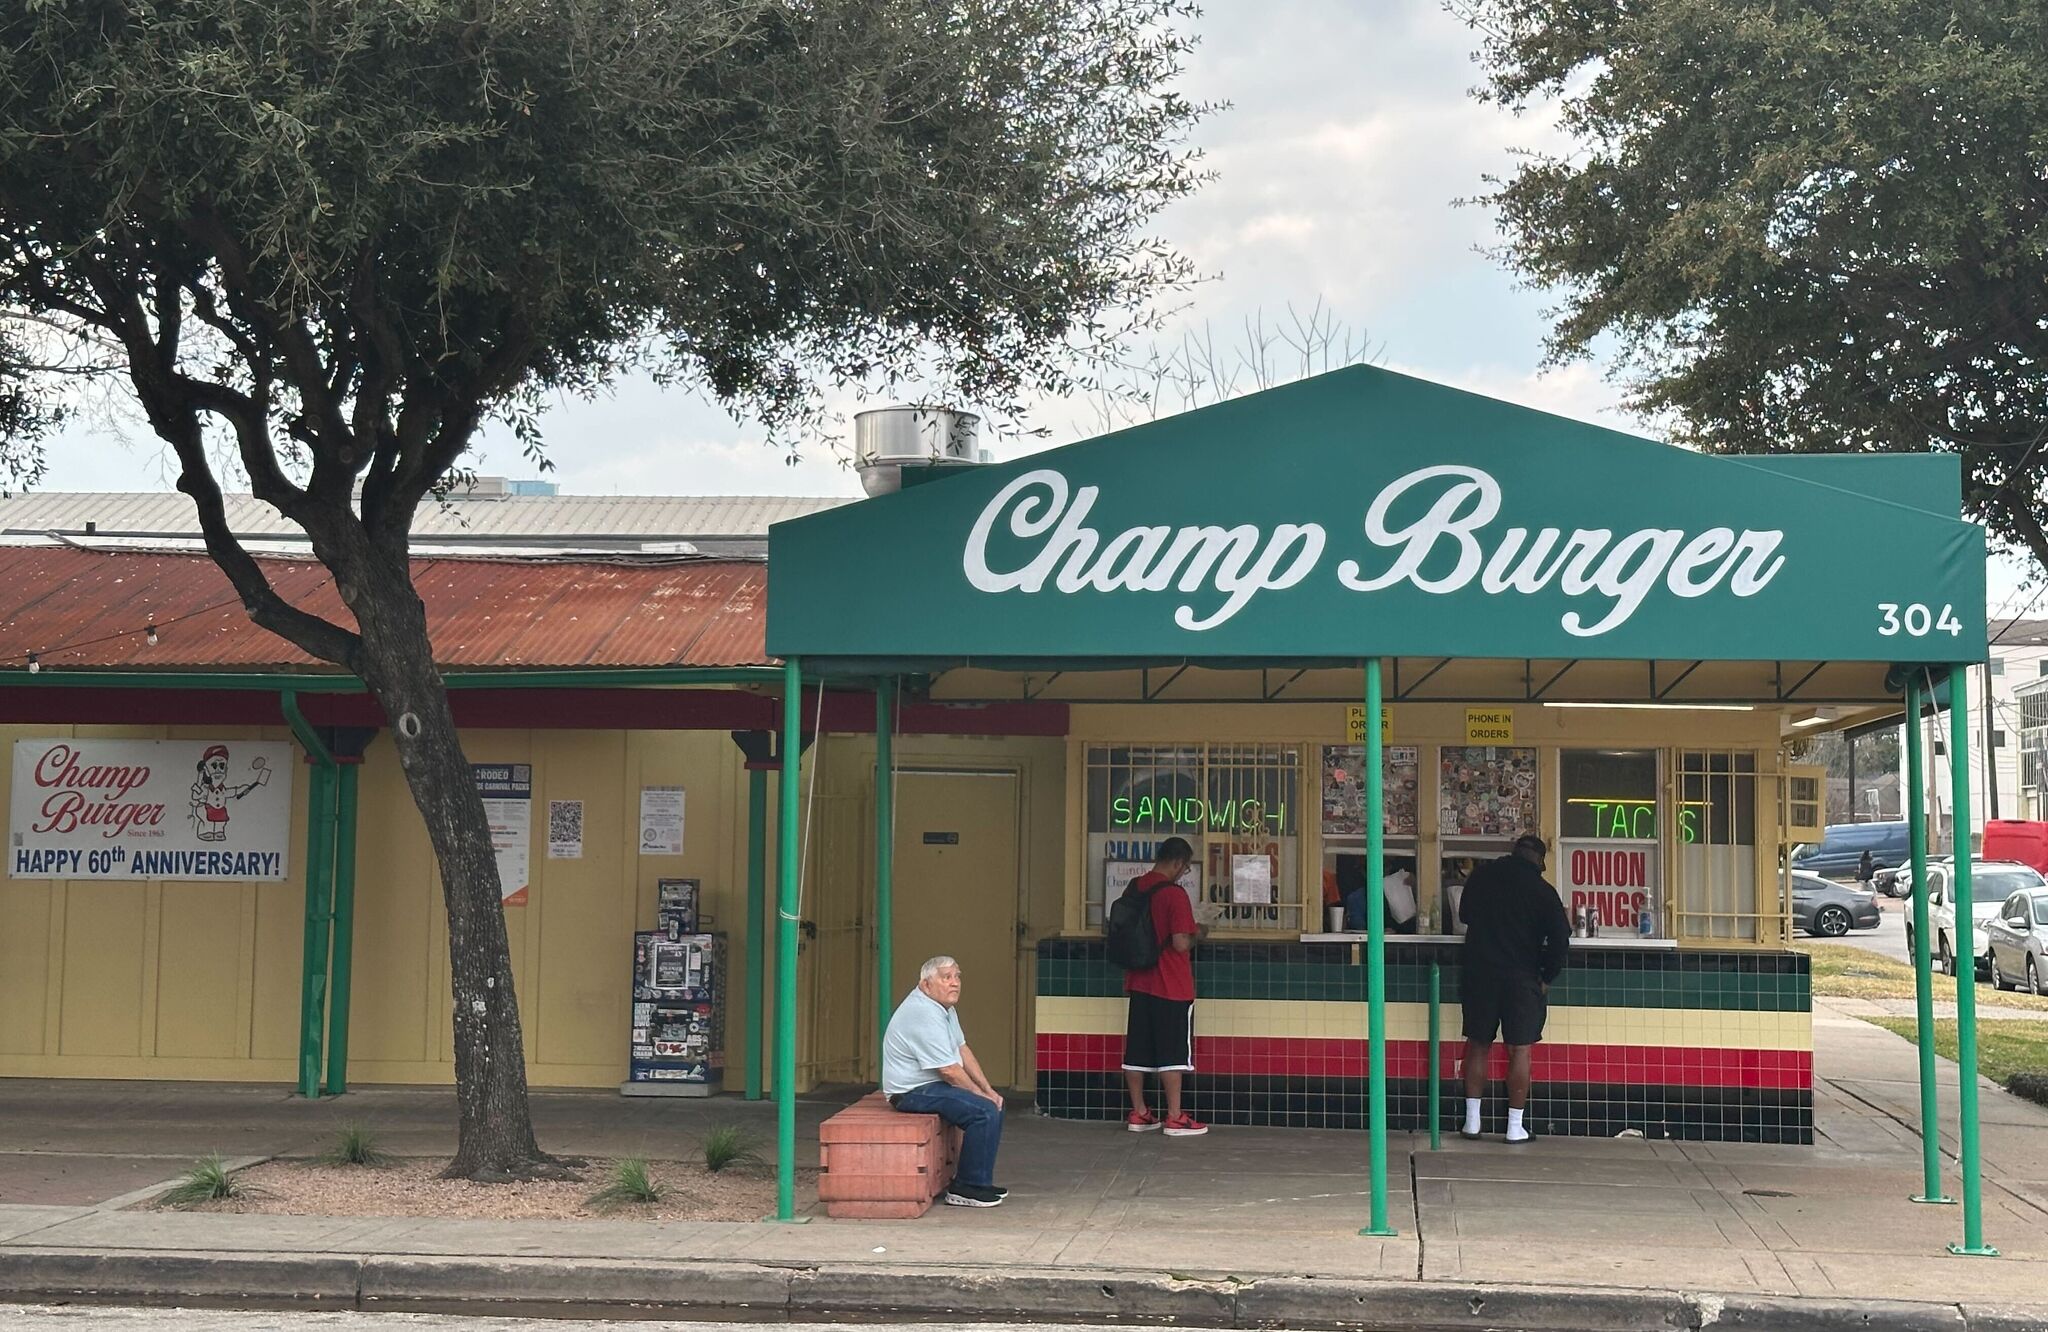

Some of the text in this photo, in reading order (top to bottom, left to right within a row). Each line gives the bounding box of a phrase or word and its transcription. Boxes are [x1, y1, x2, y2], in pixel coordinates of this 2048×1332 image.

[963, 465, 1786, 637] Champ Burger
[1877, 603, 1963, 637] 304
[1350, 720, 1389, 730] ORR
[1352, 708, 1387, 718] PLE
[1468, 714, 1512, 724] PHONE IN
[1470, 729, 1509, 739] ORDERS
[34, 744, 150, 800] Champ
[480, 770, 509, 780] RODEO
[484, 782, 511, 791] CARNIVAL
[511, 782, 530, 792] PACKS
[32, 790, 166, 838] Burger
[1113, 796, 1285, 830] SANDWICH
[1588, 803, 1697, 844] TACS
[127, 829, 147, 837] Since
[16, 846, 280, 876] HAPPY 60th ANNIVERSARY!
[1571, 849, 1646, 887] ONION
